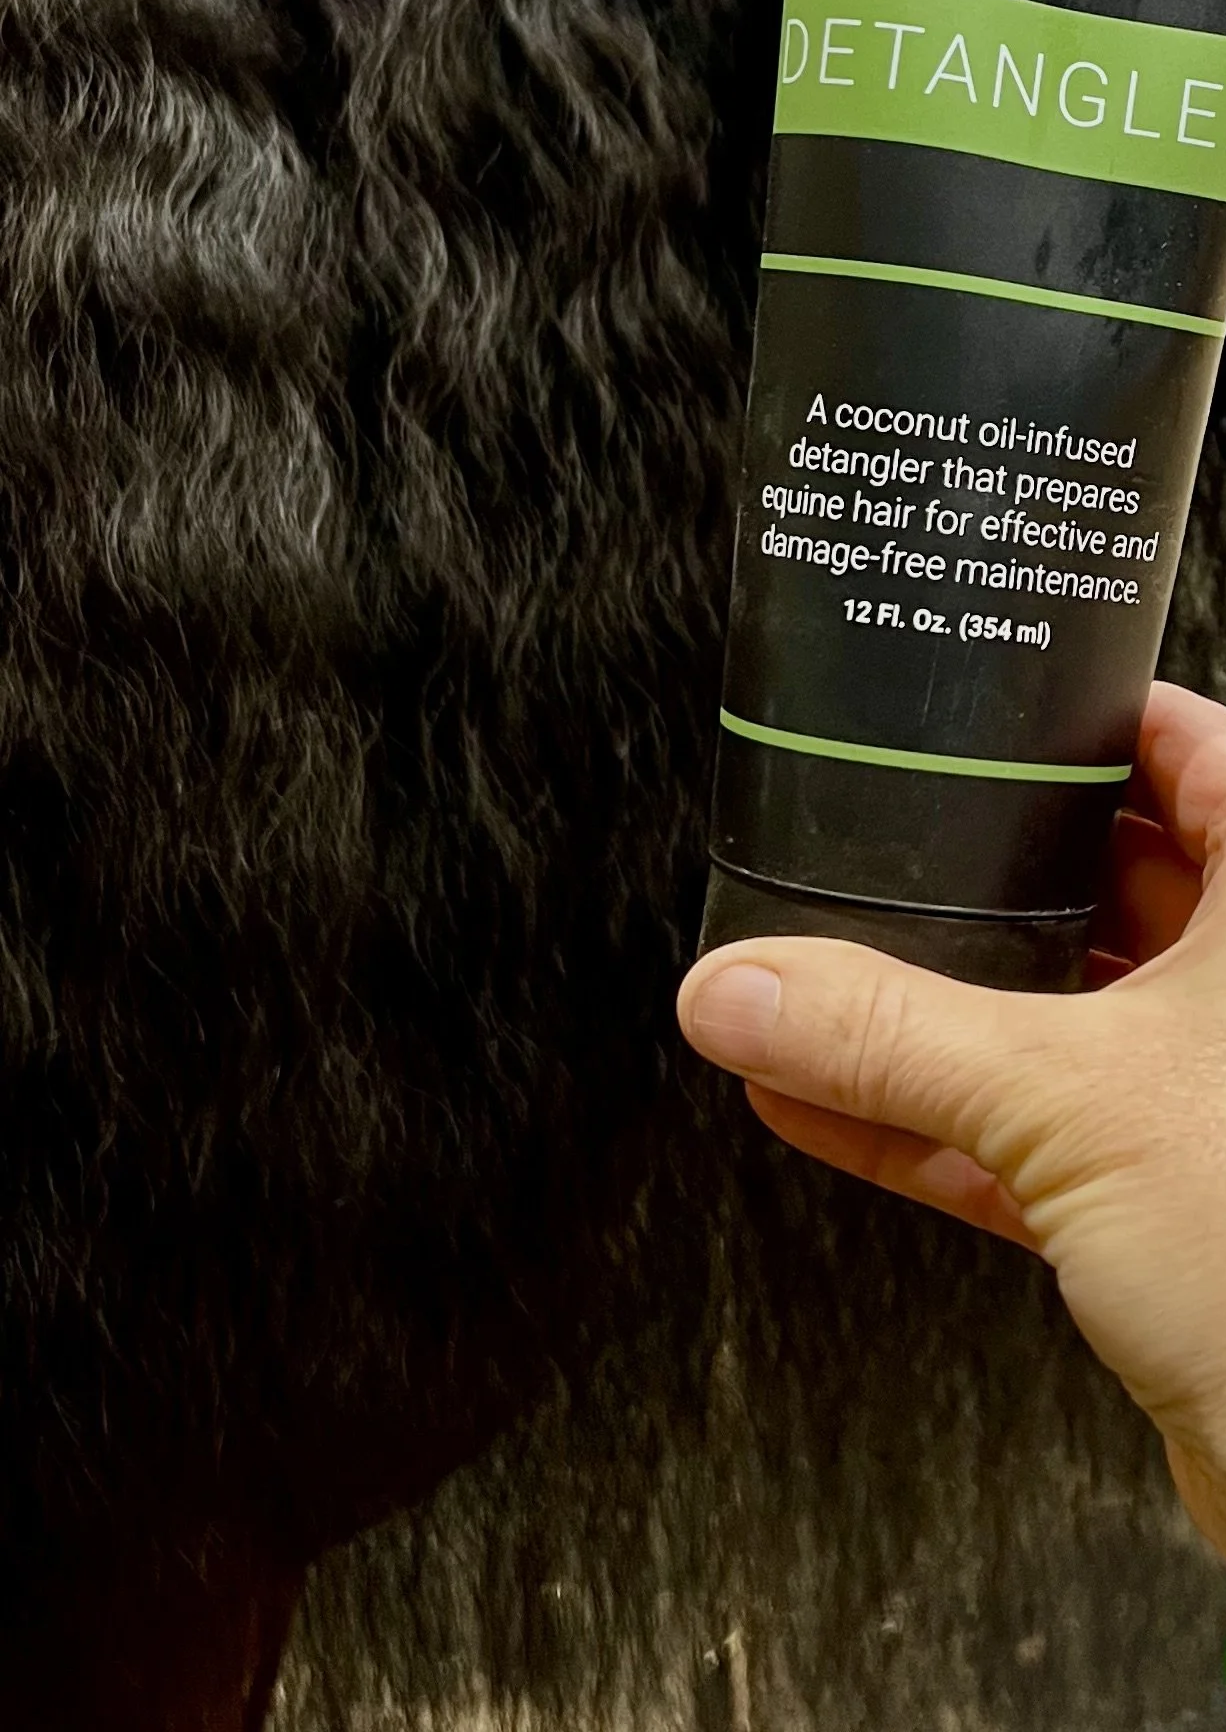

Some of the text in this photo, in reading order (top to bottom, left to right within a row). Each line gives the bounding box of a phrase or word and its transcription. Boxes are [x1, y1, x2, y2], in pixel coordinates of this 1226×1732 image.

[806, 393, 1137, 469] A coconut oil-infused
[789, 437, 1141, 515] detangler that prepares
[762, 483, 1160, 562] equine hair for effective and
[761, 524, 1142, 605] damage-free maintenance.
[843, 598, 1052, 651] 12 Fl. Oz. (354 ml)
